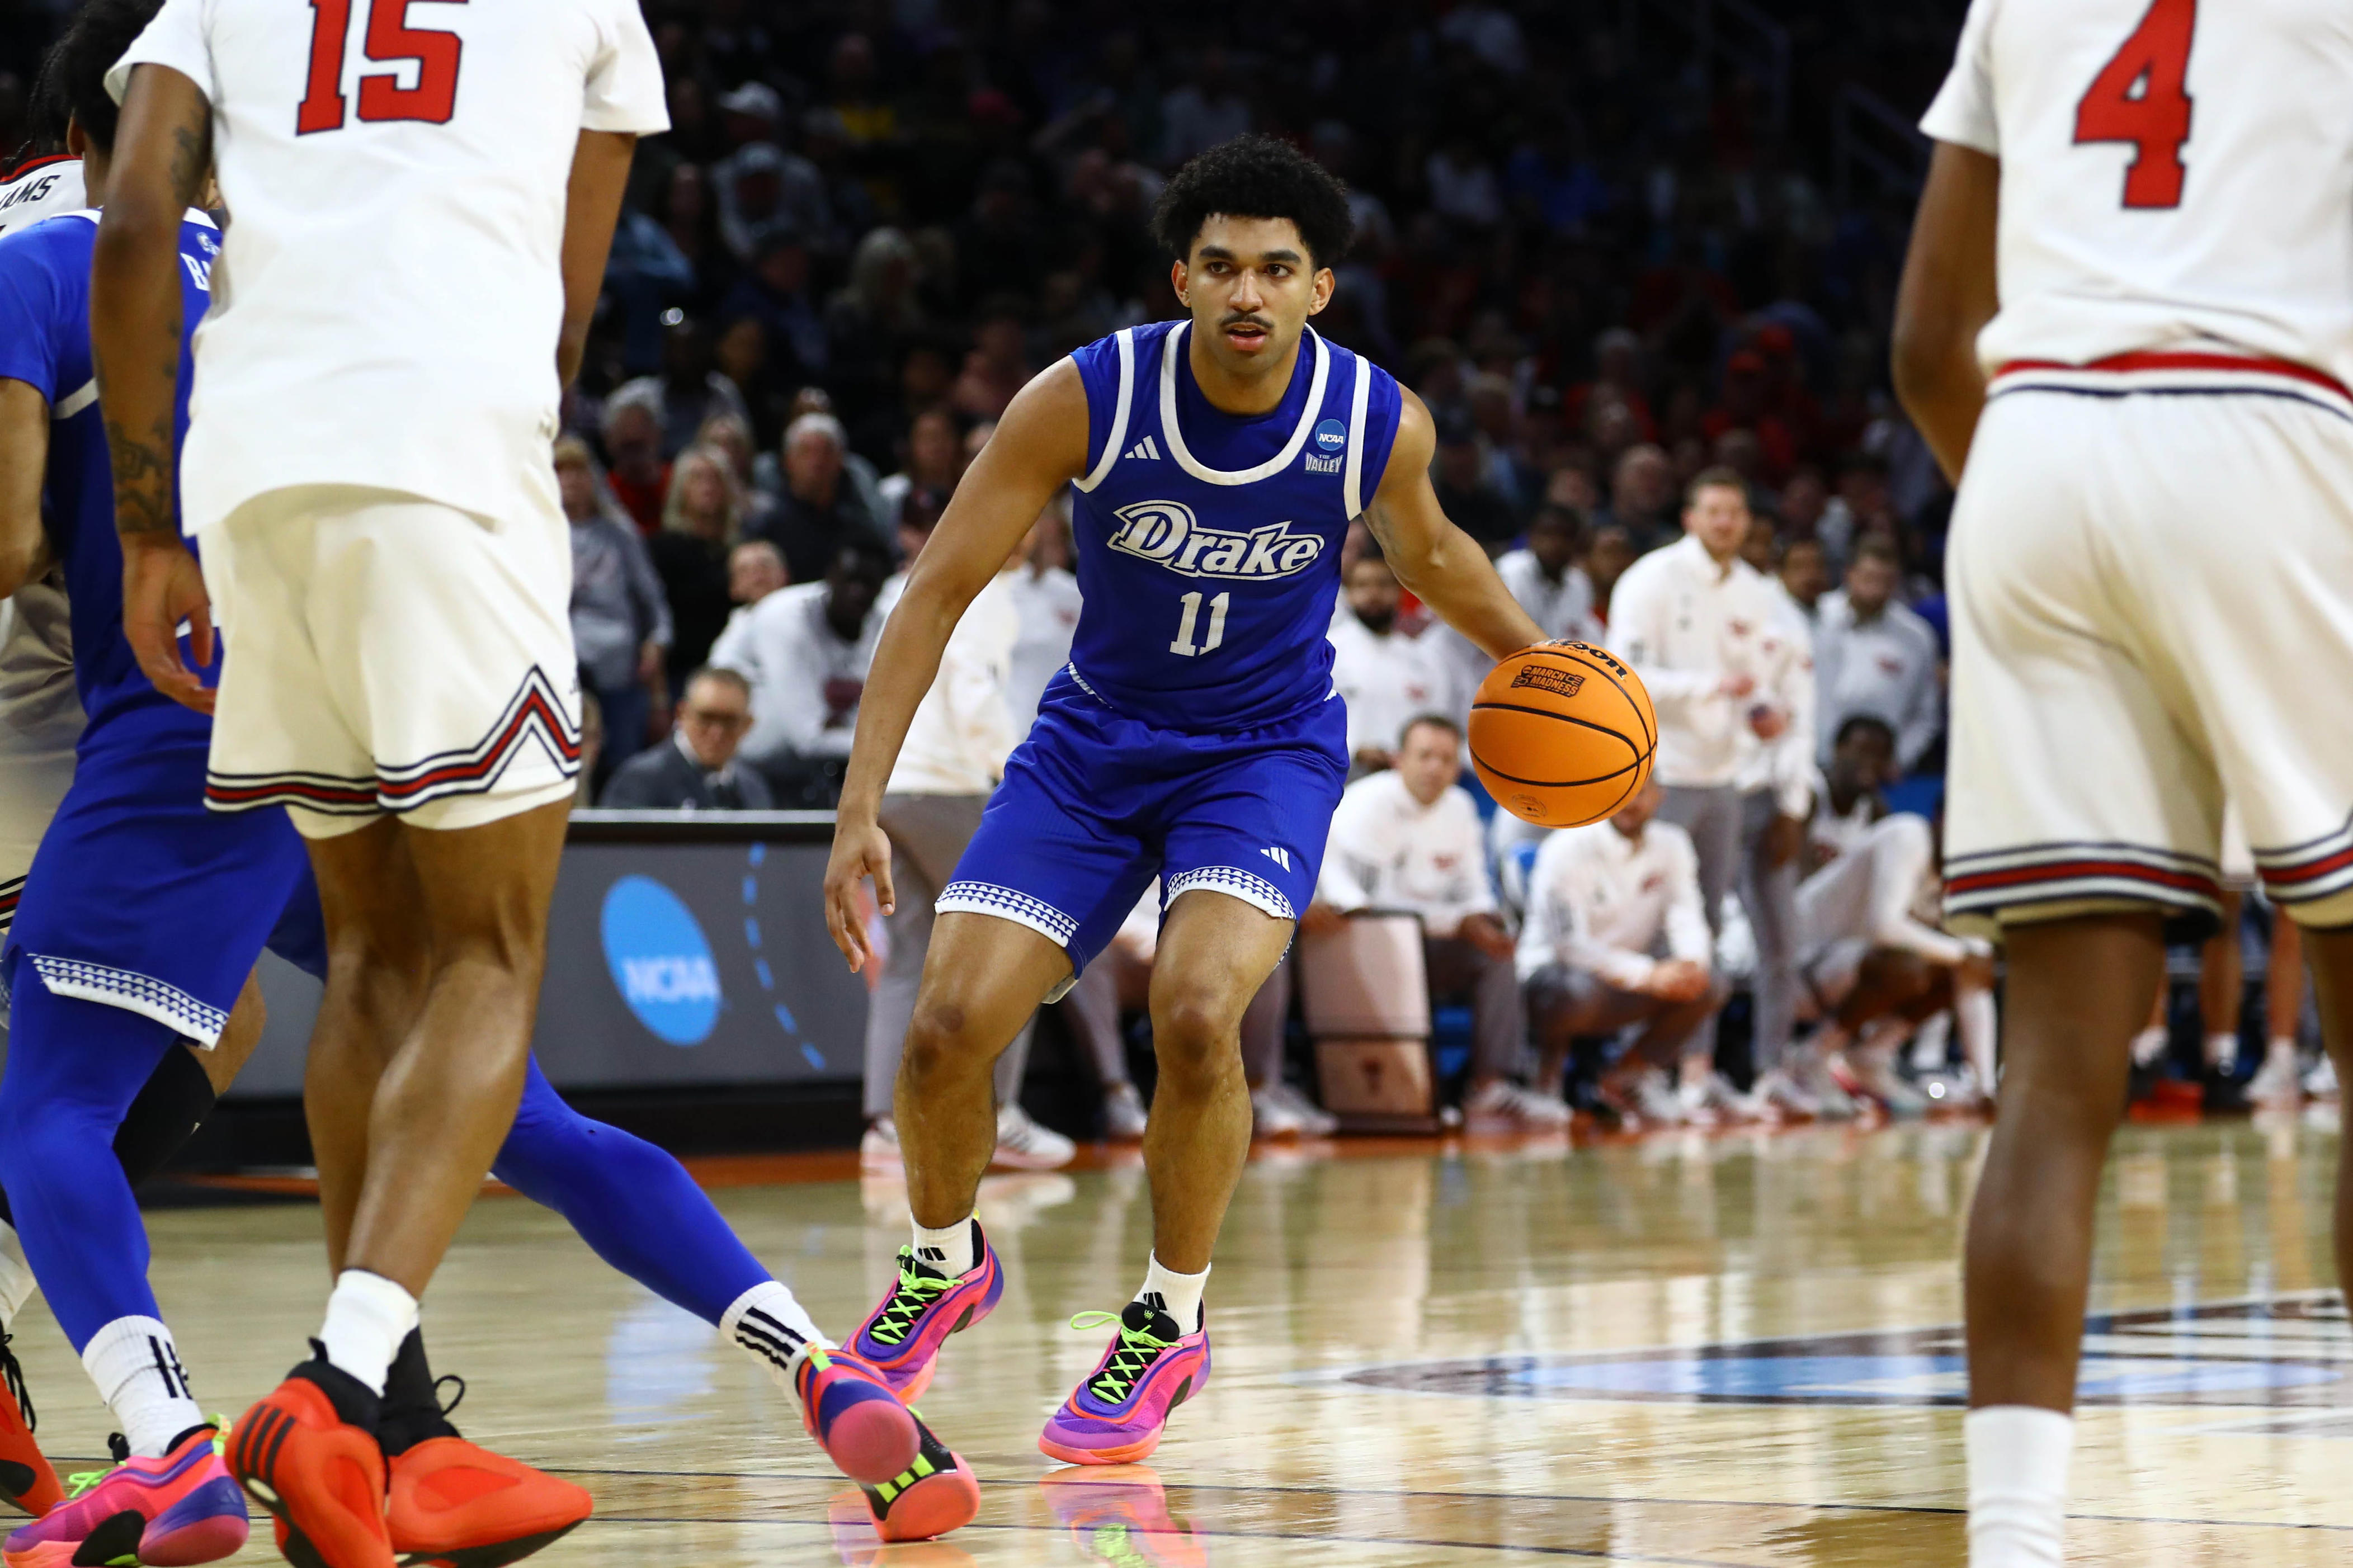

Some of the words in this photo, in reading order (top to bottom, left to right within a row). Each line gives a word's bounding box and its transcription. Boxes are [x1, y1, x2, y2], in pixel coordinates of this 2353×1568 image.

[296, 0, 468, 136] 15
[2072, 0, 2196, 209] 4
[1319, 433, 1344, 444] NCAA
[1305, 452, 1343, 473] VALLEY
[1107, 499, 1324, 580] Drake
[1170, 591, 1230, 657] 11
[1530, 675, 1578, 695] MADNESS
[1531, 667, 1566, 680] MARCH
